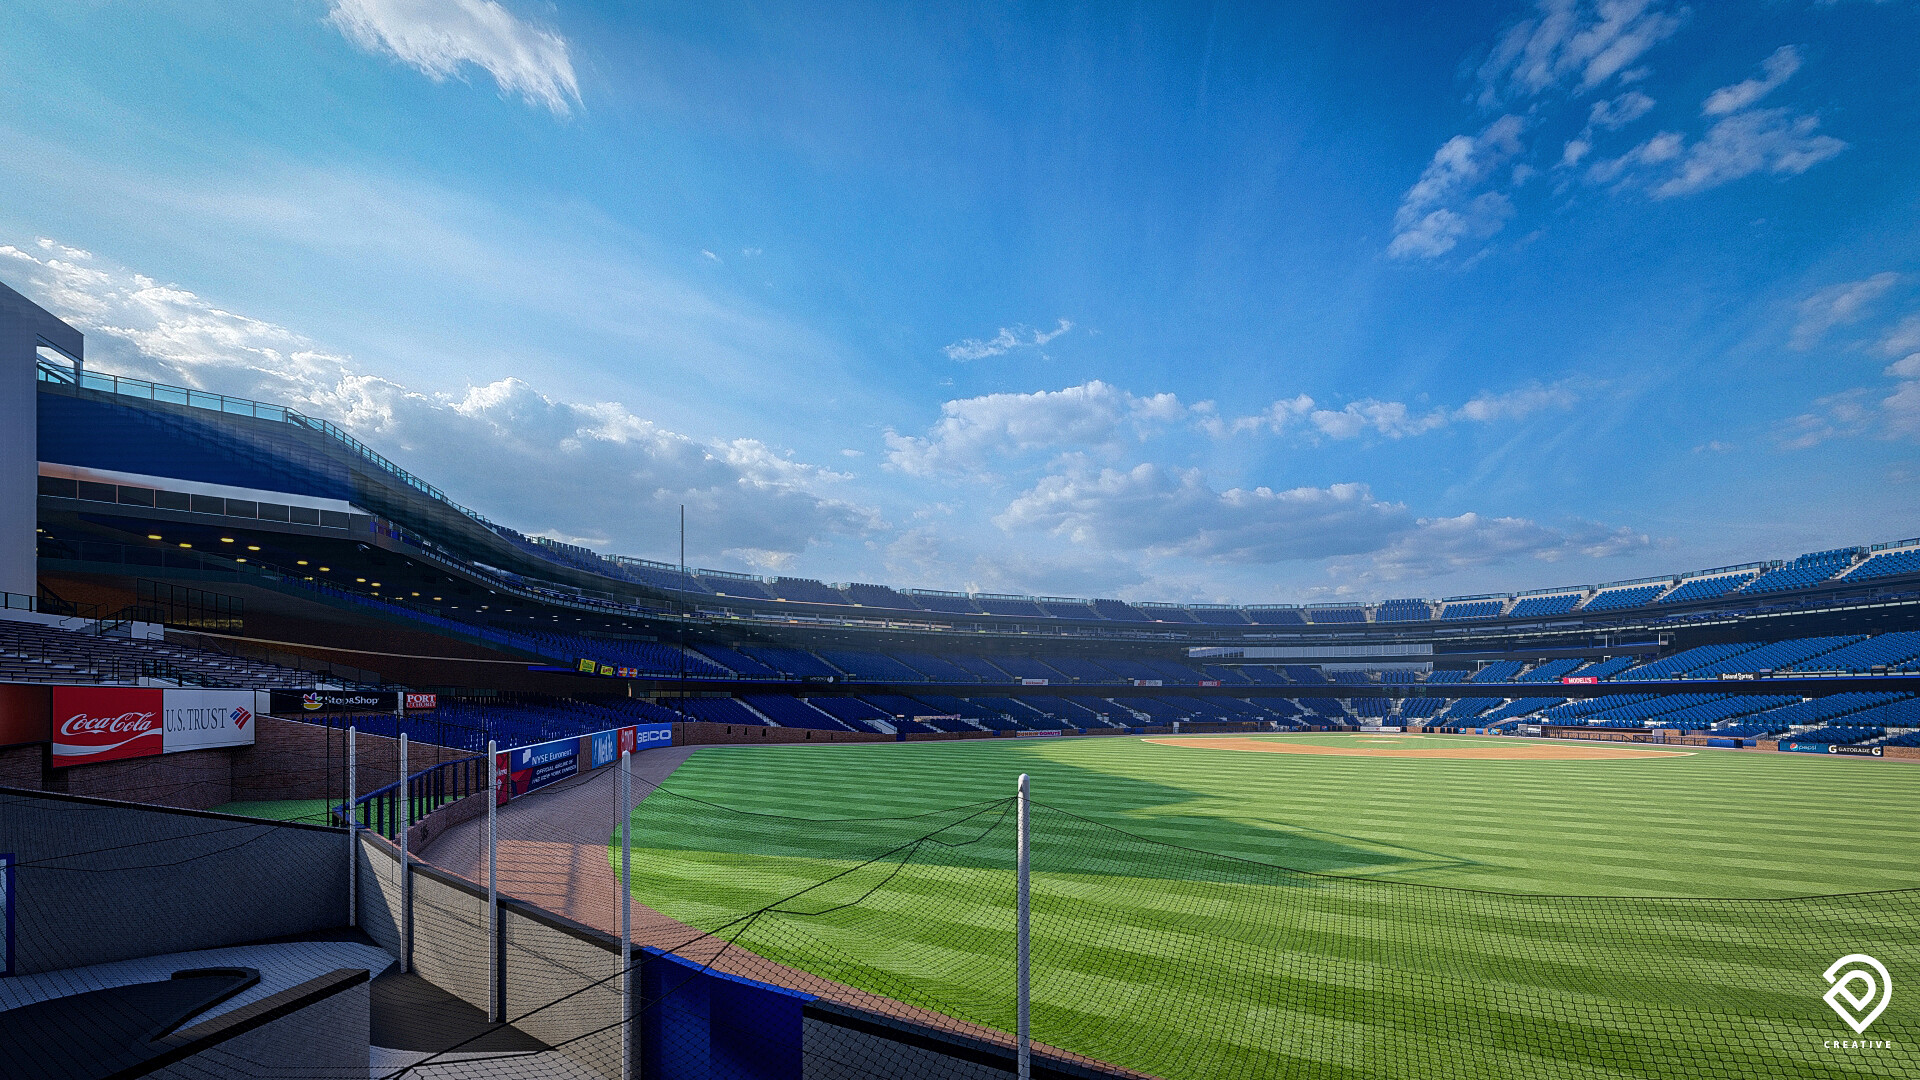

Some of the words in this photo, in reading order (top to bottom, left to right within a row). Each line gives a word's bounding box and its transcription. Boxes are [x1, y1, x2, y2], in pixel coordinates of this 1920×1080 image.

[406, 694, 437, 702] PORT
[60, 711, 156, 736] Coca-Cola
[166, 708, 185, 732] U.S.
[187, 707, 228, 730] TRUST
[637, 729, 672, 744] GEICO
[531, 753, 549, 766] NYSE
